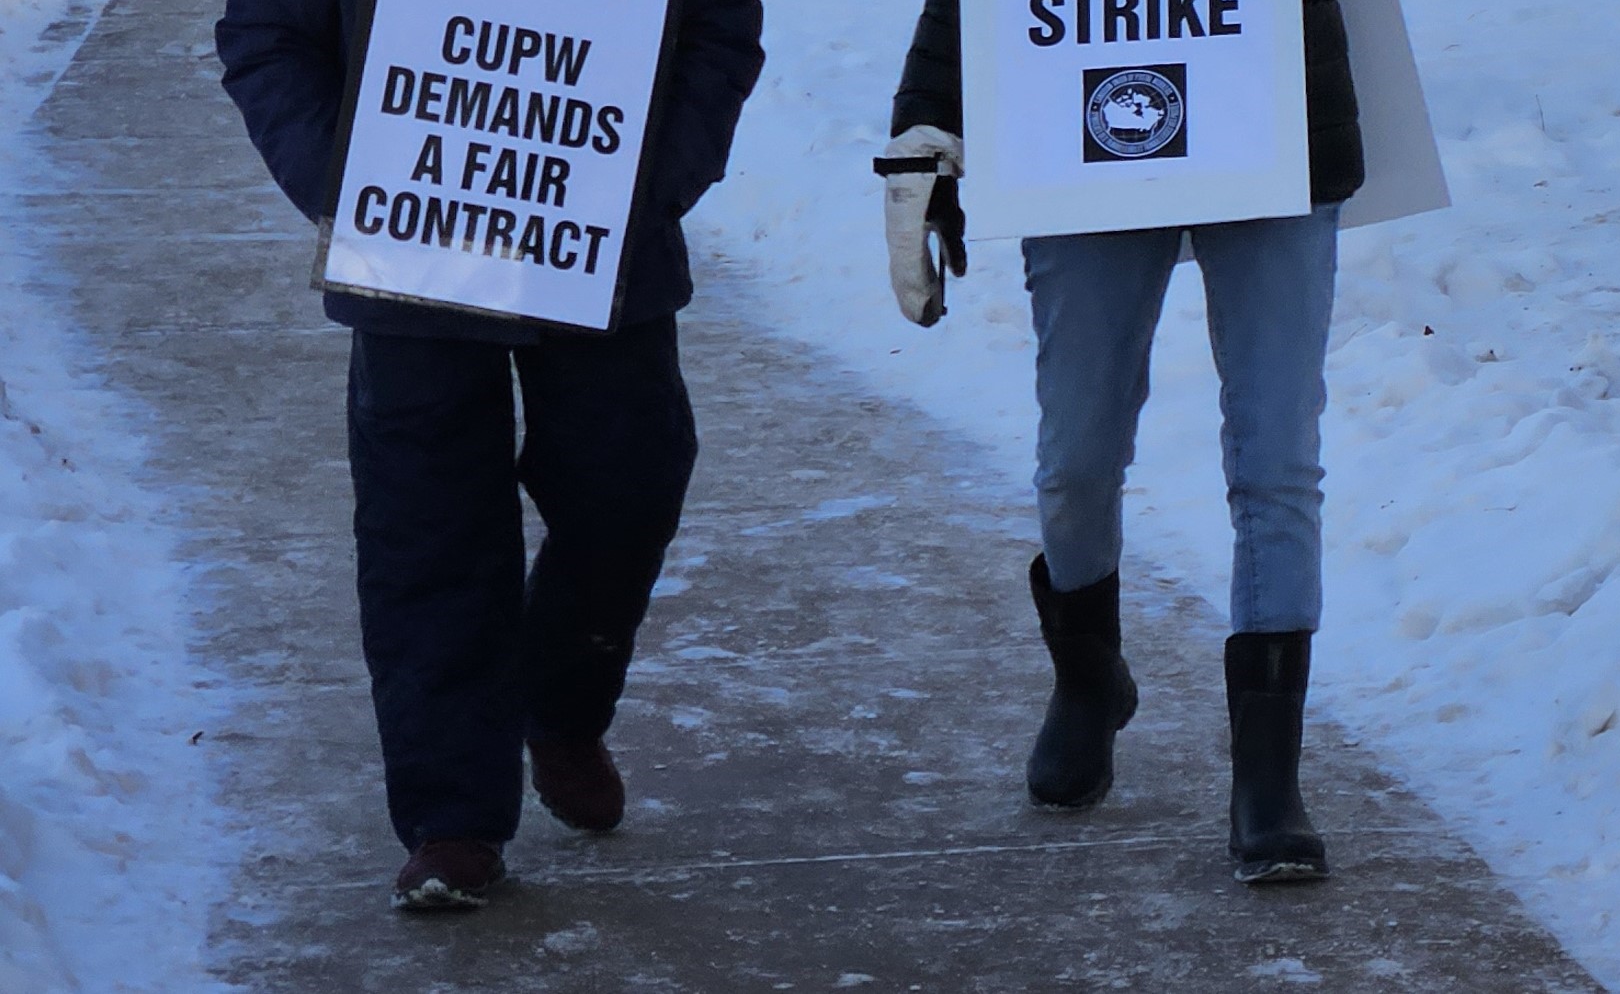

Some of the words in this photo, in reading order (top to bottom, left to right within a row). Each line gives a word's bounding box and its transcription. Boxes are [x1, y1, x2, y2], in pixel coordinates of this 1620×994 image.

[441, 15, 592, 87] CUPW
[380, 65, 624, 155] DEMANDS
[411, 134, 443, 186] A
[460, 141, 571, 208] FAIR
[353, 185, 611, 275] CONTRACT
